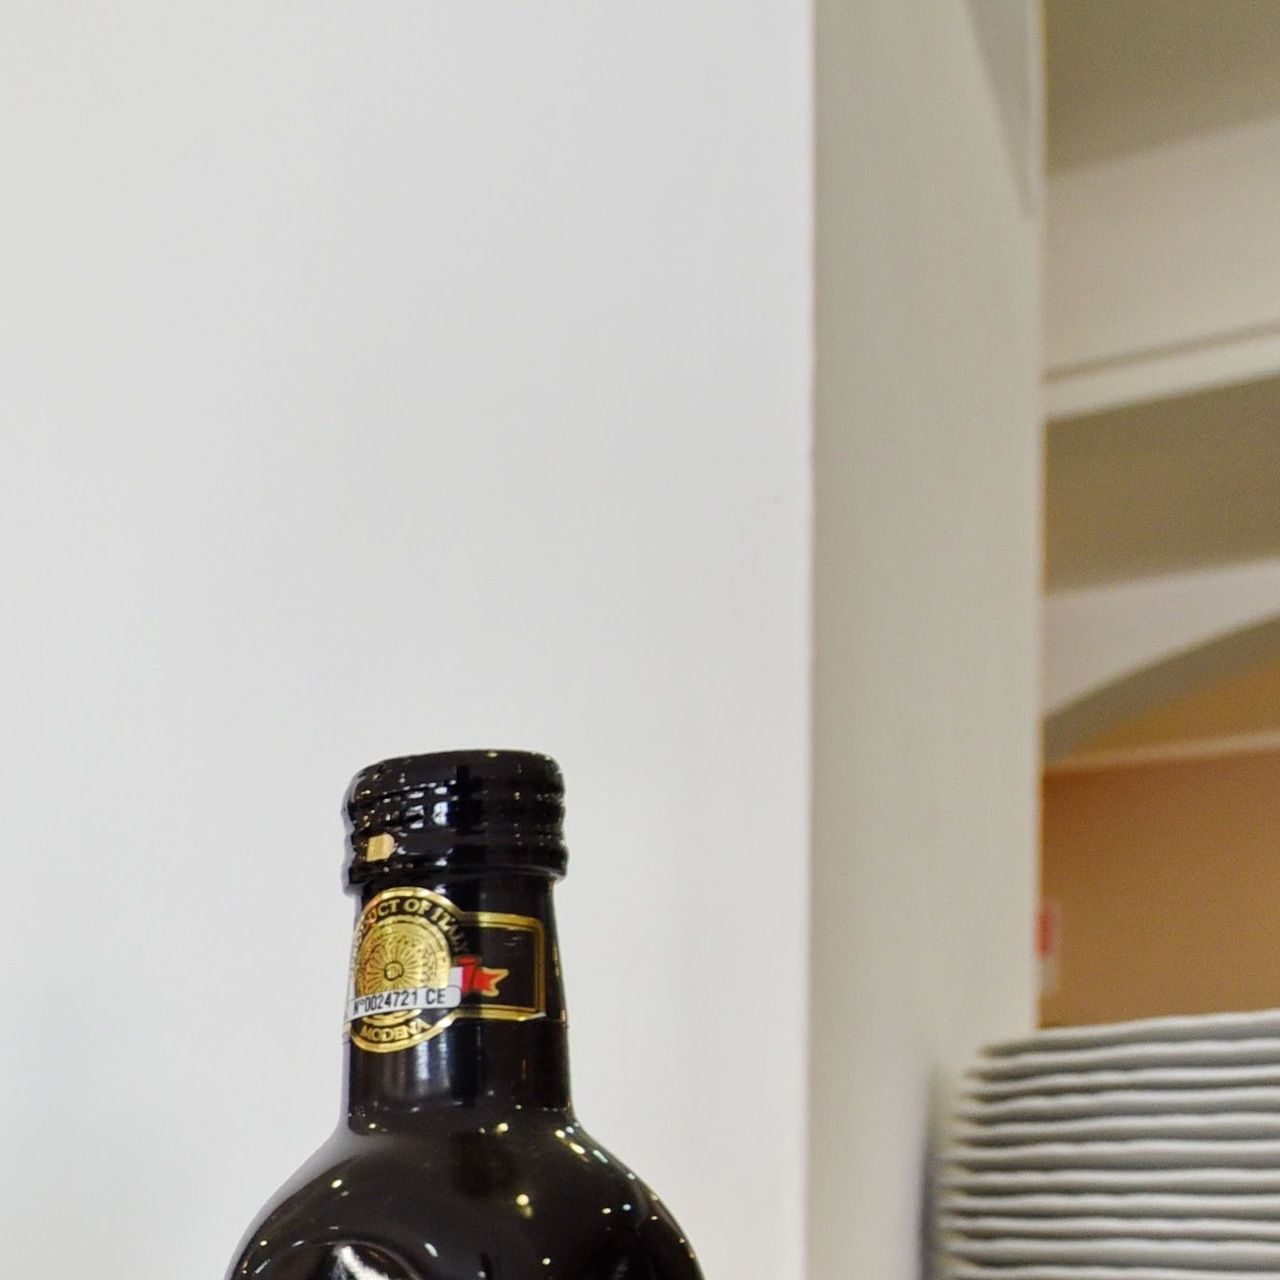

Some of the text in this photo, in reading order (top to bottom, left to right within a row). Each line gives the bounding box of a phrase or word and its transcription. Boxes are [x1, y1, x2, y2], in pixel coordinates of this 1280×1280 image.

[404, 899, 432, 915] OF
[426, 988, 447, 1004] CE
[361, 1018, 432, 1041] MODENA
